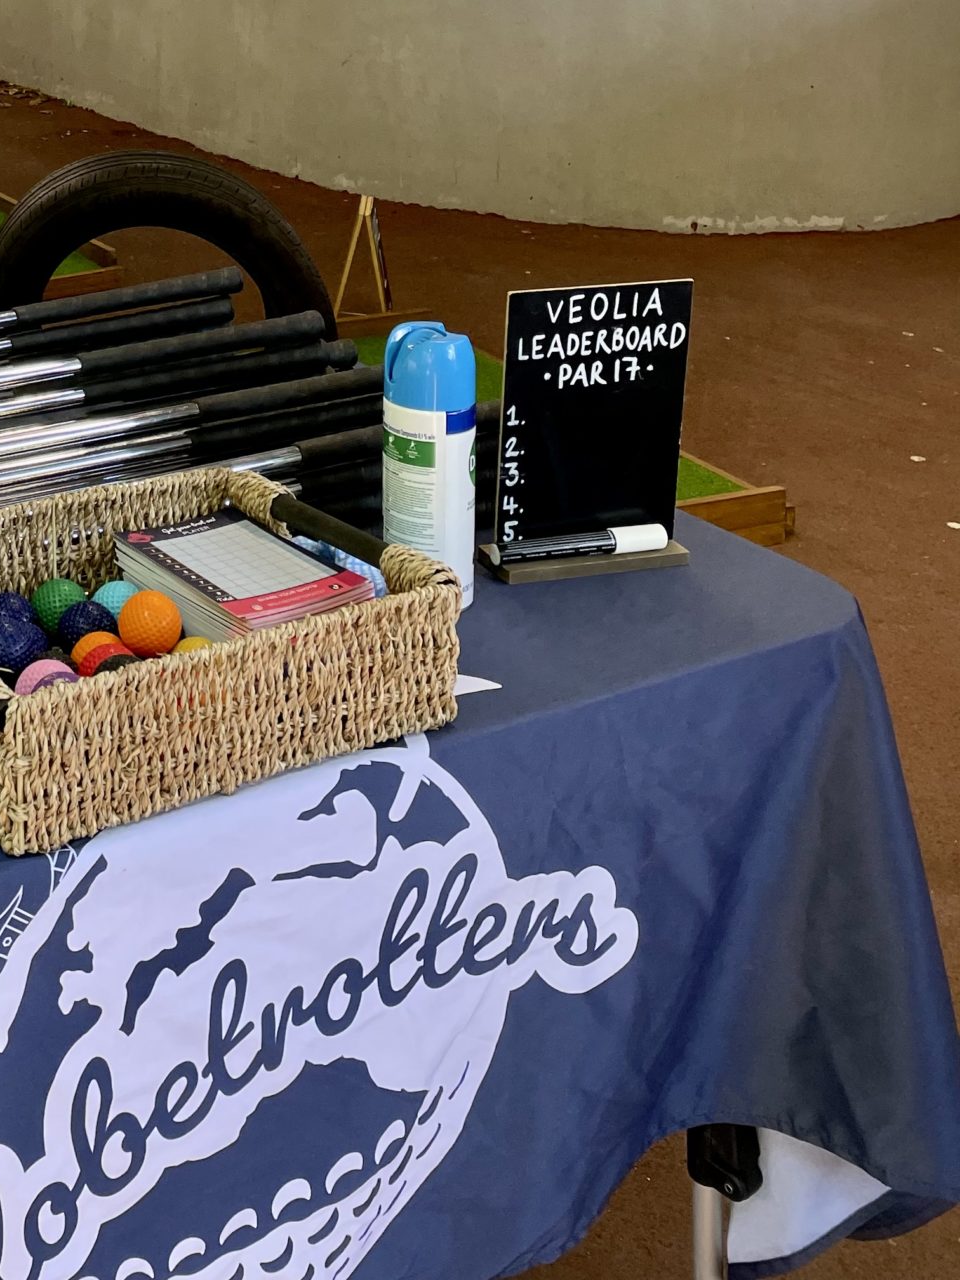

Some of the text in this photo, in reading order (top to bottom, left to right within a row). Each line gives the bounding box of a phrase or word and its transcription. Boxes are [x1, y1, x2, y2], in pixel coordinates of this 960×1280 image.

[546, 287, 664, 324] VEOLIA
[518, 322, 687, 361] LEADERBOARD
[506, 405, 526, 426] 1.
[505, 437, 525, 458] 2.
[504, 462, 525, 487] 3.
[502, 495, 524, 515] 4.
[502, 520, 523, 542] 5.
